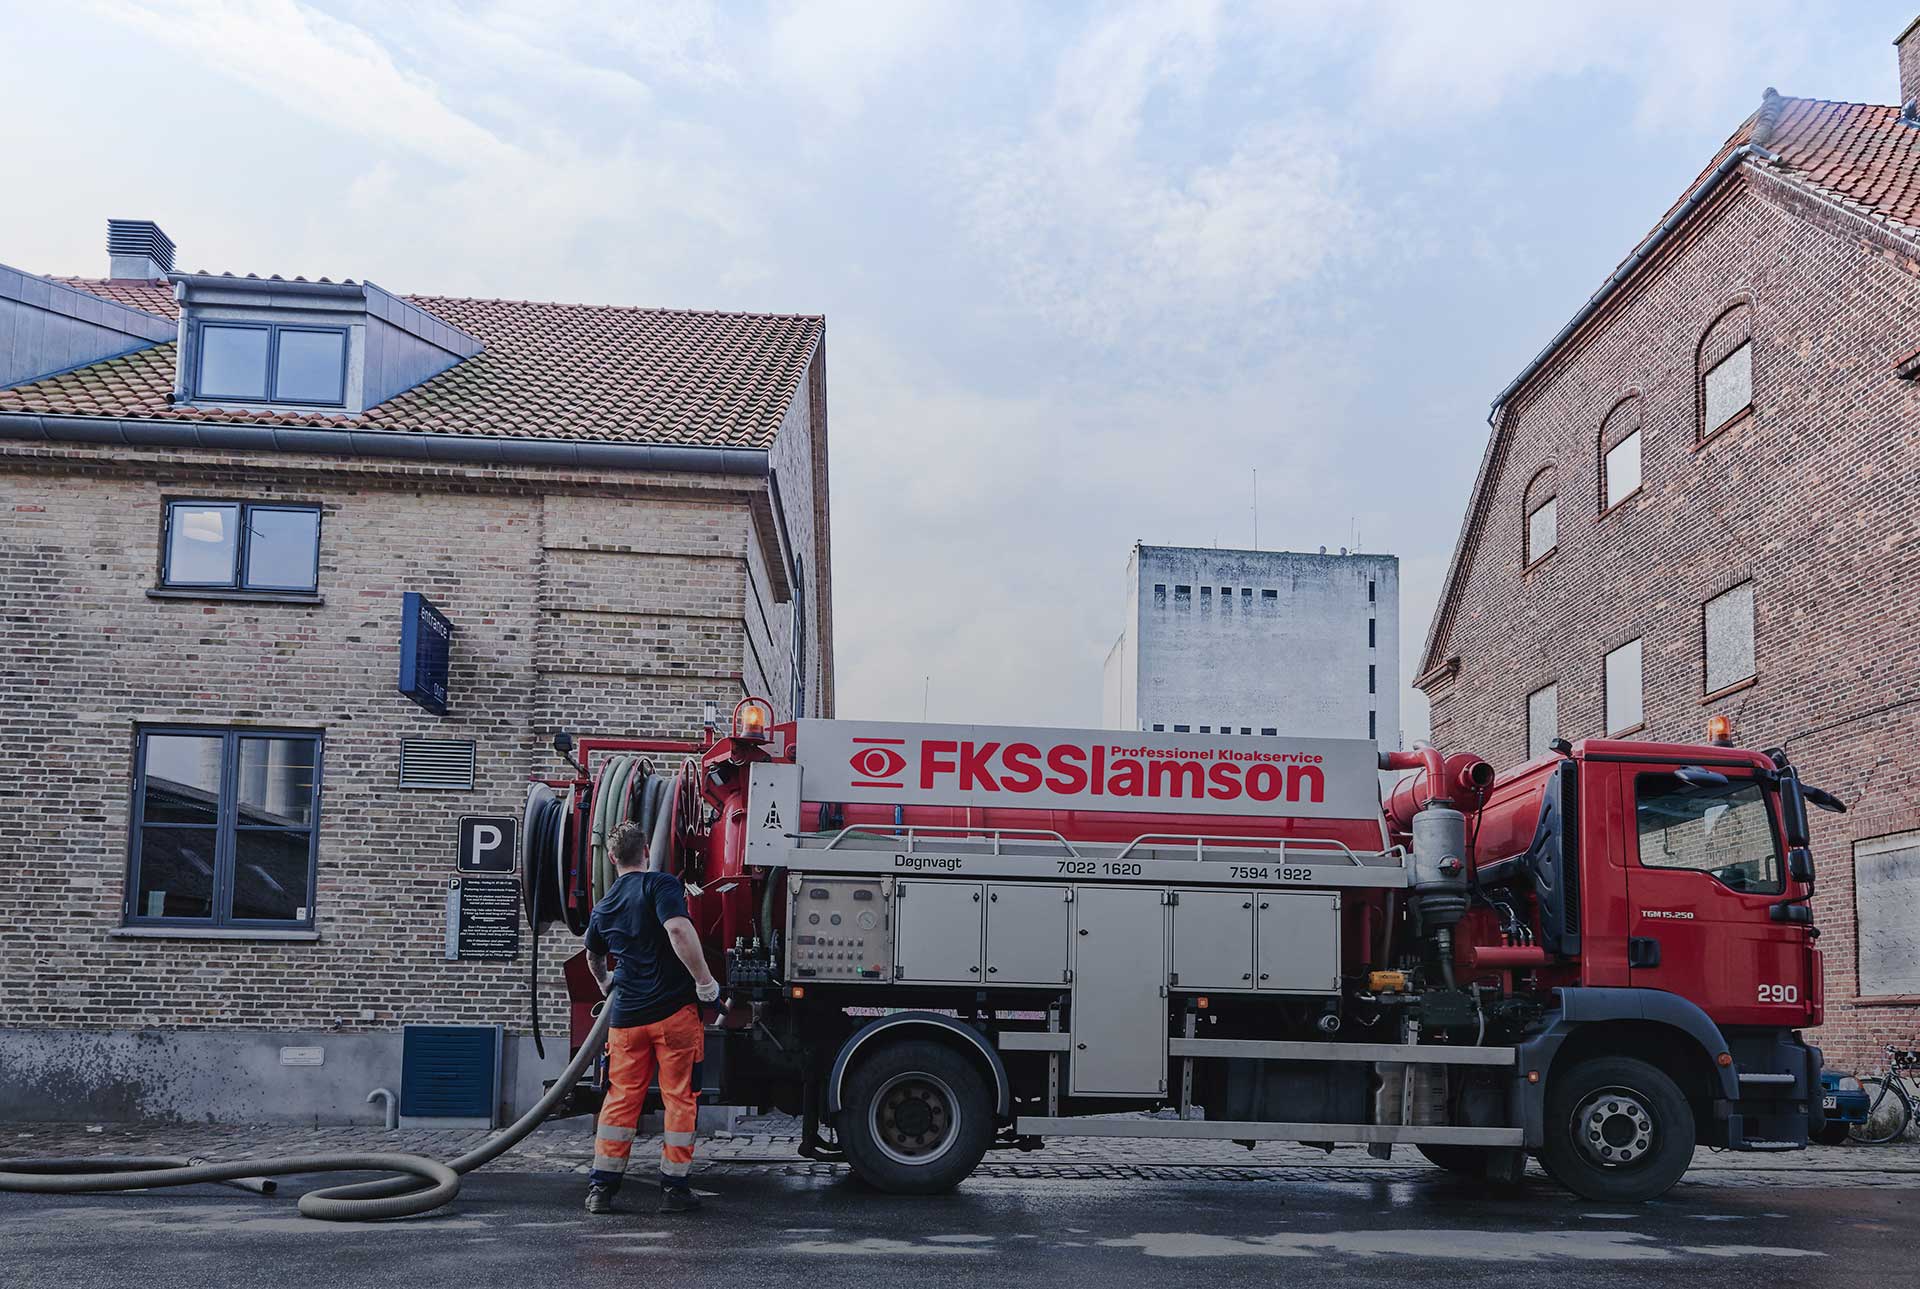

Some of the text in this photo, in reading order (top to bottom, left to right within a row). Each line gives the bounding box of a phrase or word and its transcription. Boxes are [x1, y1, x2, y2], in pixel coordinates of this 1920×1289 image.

[420, 607, 448, 640] entrance
[1110, 745, 1323, 764] Professionel Kloakservice
[471, 824, 503, 865] P
[894, 854, 962, 871] Døgnvagt
[1056, 861, 1142, 876] 7022 1620
[1229, 866, 1312, 881] 7594 1922
[450, 879, 459, 889] P
[1641, 910, 1661, 918] TGM
[1758, 984, 1798, 1003] 290
